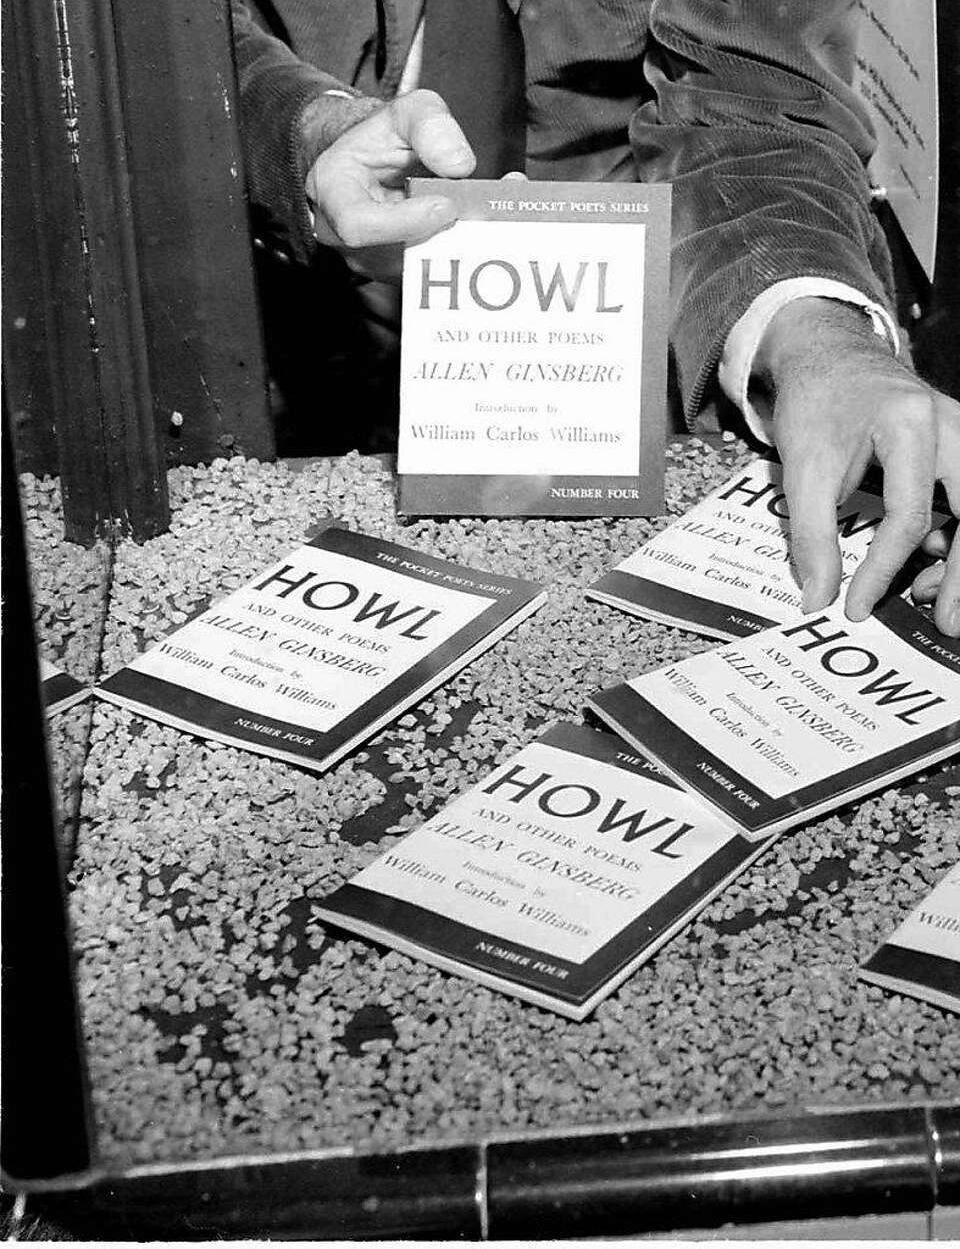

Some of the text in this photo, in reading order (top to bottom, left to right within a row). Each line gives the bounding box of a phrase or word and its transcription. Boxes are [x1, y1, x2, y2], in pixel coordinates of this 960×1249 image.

[489, 201, 649, 213] THE POCKET POETS SERIES
[419, 259, 623, 312] HOWL
[434, 330, 604, 345] AND OTHER POEMS
[413, 362, 622, 382] ALLEN GINSBERG
[411, 425, 622, 443] William Carlos Williams
[550, 488, 639, 499] NUMBER FOUR
[715, 511, 745, 523] AND
[676, 522, 750, 546] ALLEN
[642, 547, 696, 572] William
[705, 568, 751, 589] Carlos
[253, 564, 442, 641] HOWL
[200, 615, 386, 678] ALLEN GINSBERG
[242, 603, 391, 653] AND OTHER POEMS
[159, 643, 337, 711] William Carlos Williams
[762, 648, 879, 731] AND OTHER POEMS
[780, 616, 947, 726] HOWL
[665, 669, 799, 777] William Carlos Williams
[717, 651, 864, 753] ALLEN GINSBERG
[234, 718, 314, 746] NUMBER FOUR
[616, 752, 640, 765] THE
[697, 761, 760, 810] NUMBER FOUR
[482, 764, 696, 860] HOWL
[427, 822, 640, 900] ALLEN GINSBERG
[472, 808, 641, 873] AND OTHER POEMS
[385, 855, 591, 937] William Carlos Williams
[476, 942, 569, 979] NUMBER FOUR
